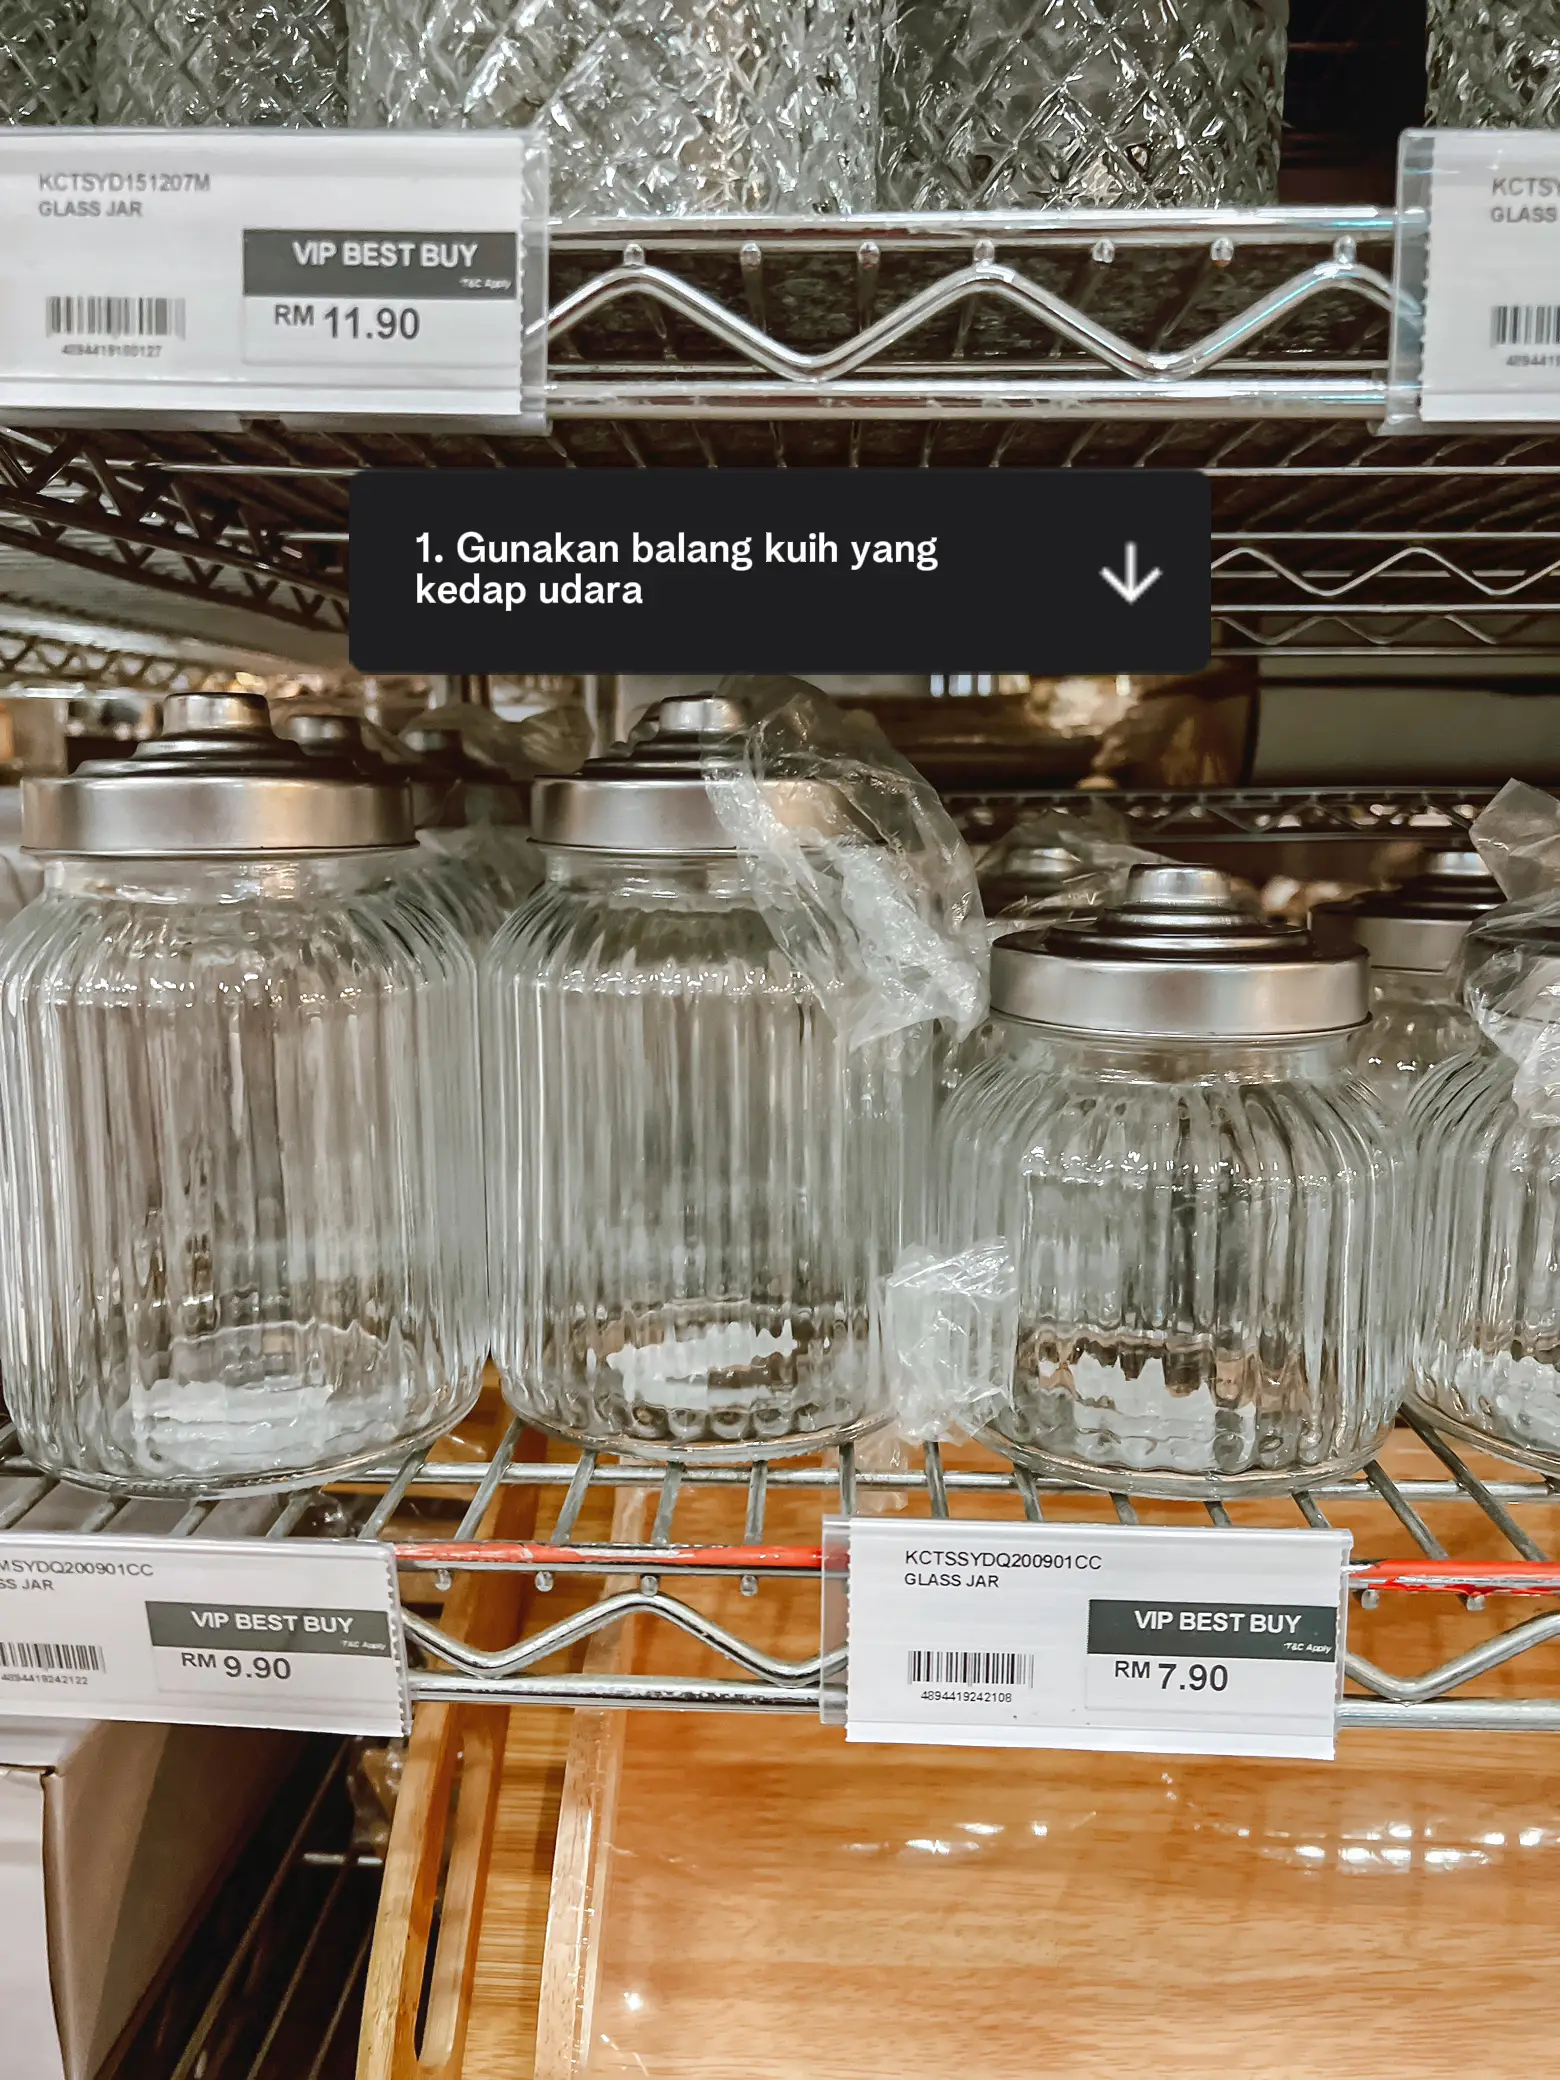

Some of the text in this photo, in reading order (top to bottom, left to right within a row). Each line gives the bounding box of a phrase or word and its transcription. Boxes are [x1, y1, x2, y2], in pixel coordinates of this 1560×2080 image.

[39, 201, 143, 217] GLASS JAR
[1491, 205, 1557, 223] GLASS
[292, 241, 478, 268] VIP BEST BUY
[274, 304, 420, 340] RM 11.90
[905, 1551, 1102, 1570] KCTSSYDQ200901CC
[22, 1579, 54, 1591] JAR
[904, 1573, 1000, 1588] GLASS JAR
[191, 1611, 353, 1634] VIP BEST BUY
[1134, 1610, 1302, 1634] VIP BEST BUY
[1305, 1643, 1332, 1654] Apply
[181, 1652, 291, 1680] RM 9.90
[1115, 1661, 1229, 1692] RM 7.90
[921, 1690, 1012, 1703] 4894419242108
